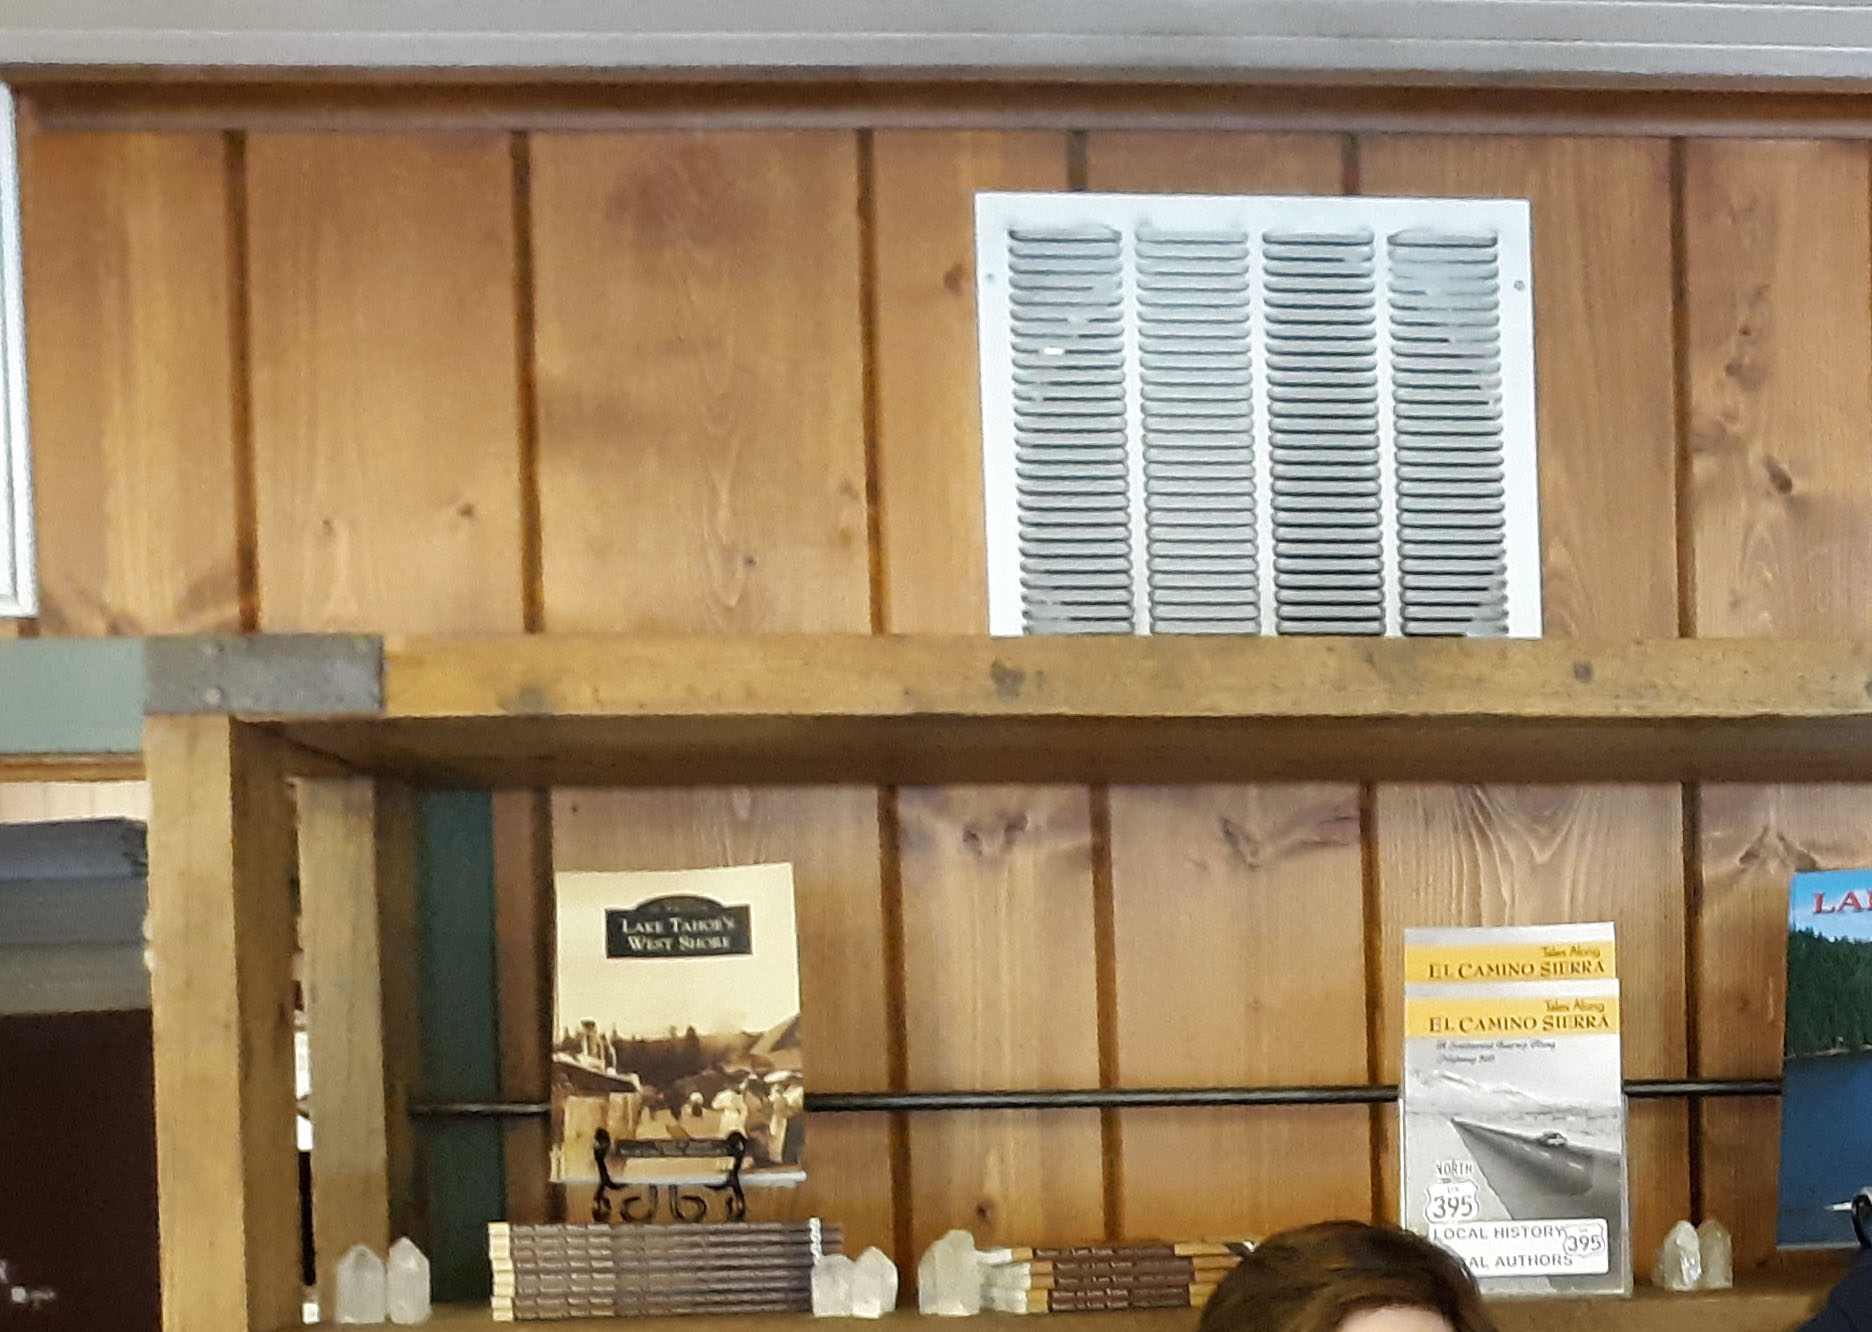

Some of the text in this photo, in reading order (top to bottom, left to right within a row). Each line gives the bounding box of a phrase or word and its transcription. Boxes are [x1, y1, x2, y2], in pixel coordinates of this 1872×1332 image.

[621, 917, 664, 933] LAKE
[628, 935, 731, 950] WEST SHORE
[1429, 960, 1606, 978] EL CAMINO SIERRA
[1429, 1014, 1609, 1033] EL CAMINO SIERRA
[1433, 1195, 1473, 1219] 395
[1433, 1226, 1564, 1241] LOCAL HISTORY
[1568, 1234, 1601, 1251] 395
[1494, 1254, 1573, 1268] AUTHORS
